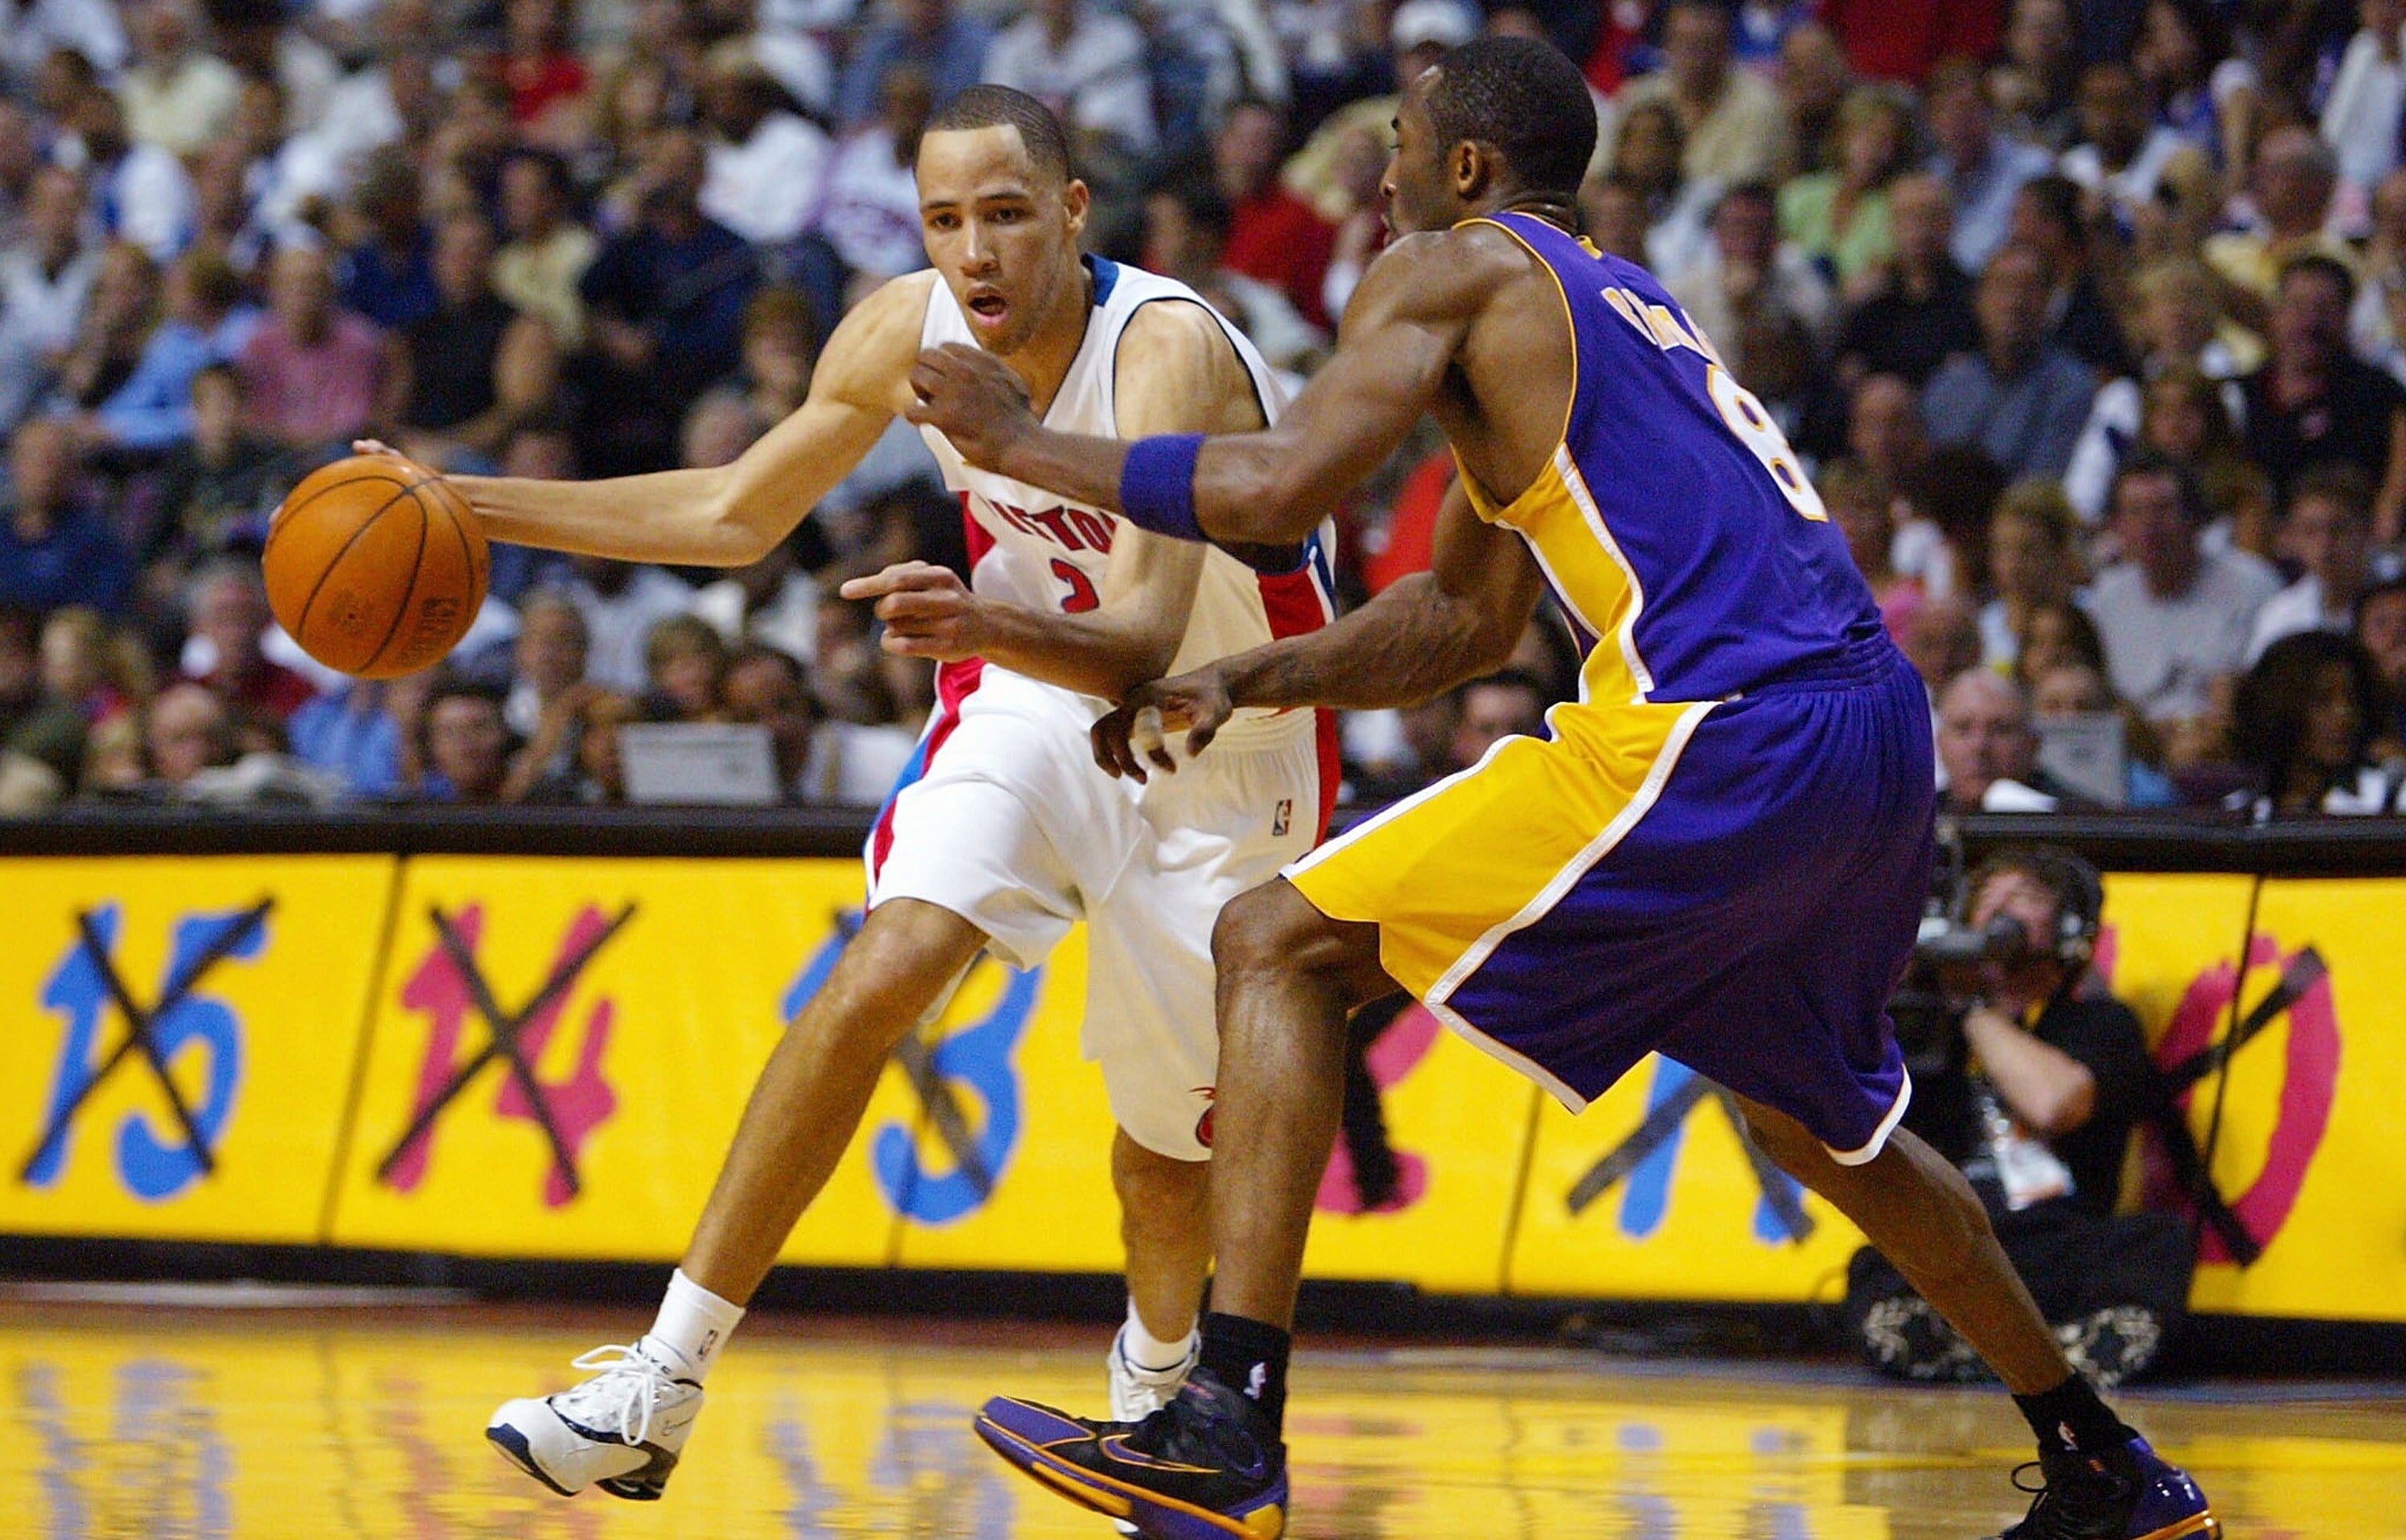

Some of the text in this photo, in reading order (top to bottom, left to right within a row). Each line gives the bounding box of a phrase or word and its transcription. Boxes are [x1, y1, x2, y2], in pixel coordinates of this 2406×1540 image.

[1707, 364, 1829, 522] 8
[27, 902, 268, 1201] 15
[388, 903, 618, 1209] 14
